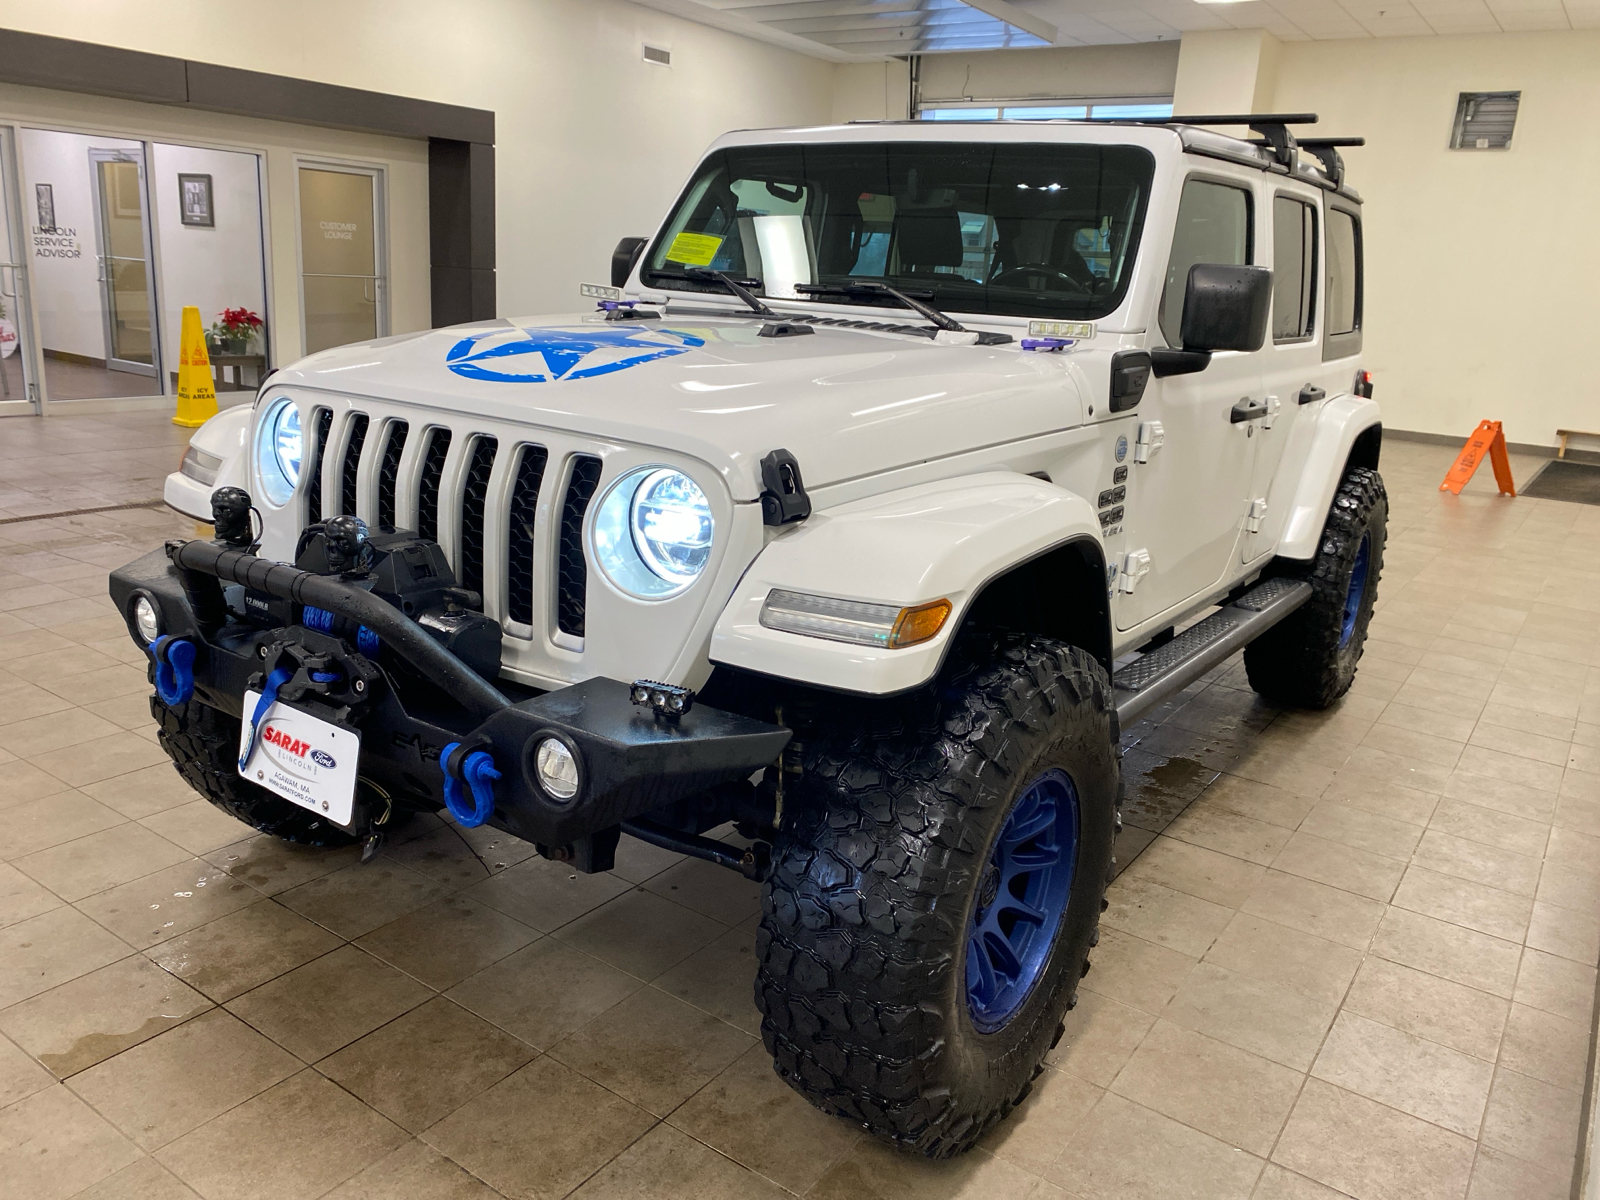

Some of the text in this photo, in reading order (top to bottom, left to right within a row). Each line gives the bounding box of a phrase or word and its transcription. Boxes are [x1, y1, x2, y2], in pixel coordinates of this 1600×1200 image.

[32, 226, 77, 237] LINCOLN
[319, 221, 357, 231] CUSTOMER
[324, 230, 353, 240] LOUNGE
[33, 236, 74, 247] SERVICE
[35, 248, 81, 259] ADVISOR
[263, 725, 311, 759] SARAT
[281, 752, 313, 773] LINCOLN
[313, 750, 335, 768] Ford
